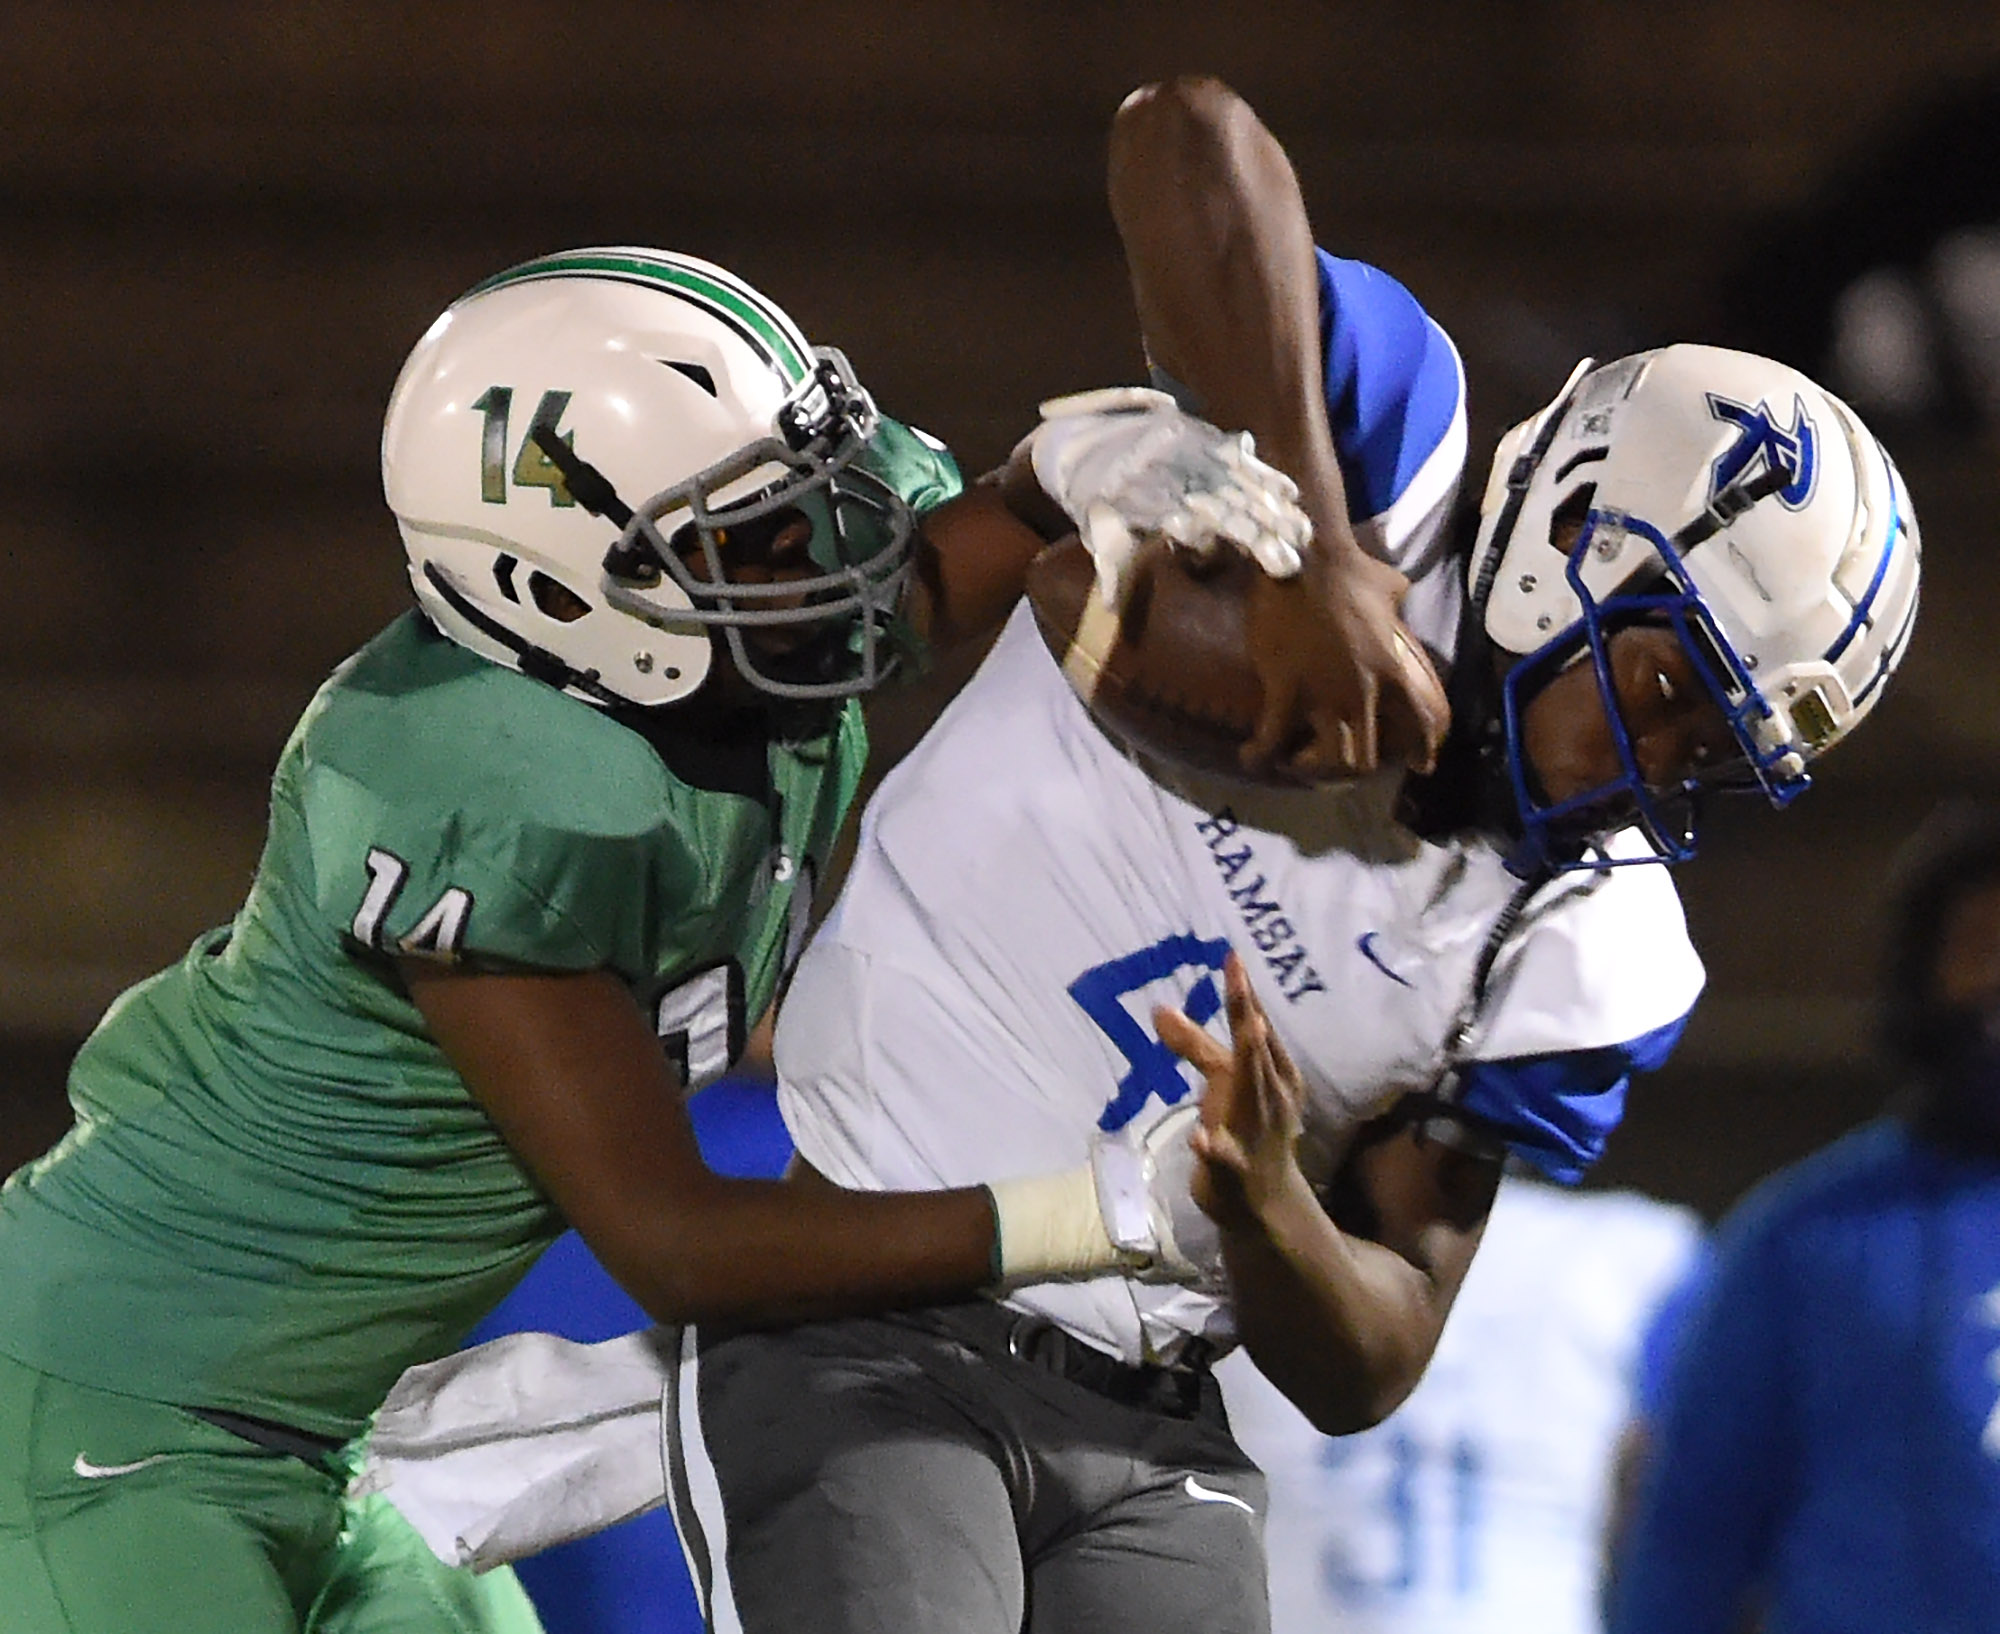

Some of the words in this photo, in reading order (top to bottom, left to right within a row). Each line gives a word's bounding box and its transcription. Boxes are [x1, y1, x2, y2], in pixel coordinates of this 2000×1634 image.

[471, 386, 577, 508] 14
[1195, 806, 1328, 1004] RAMSAY
[1066, 930, 1236, 1132] 4
